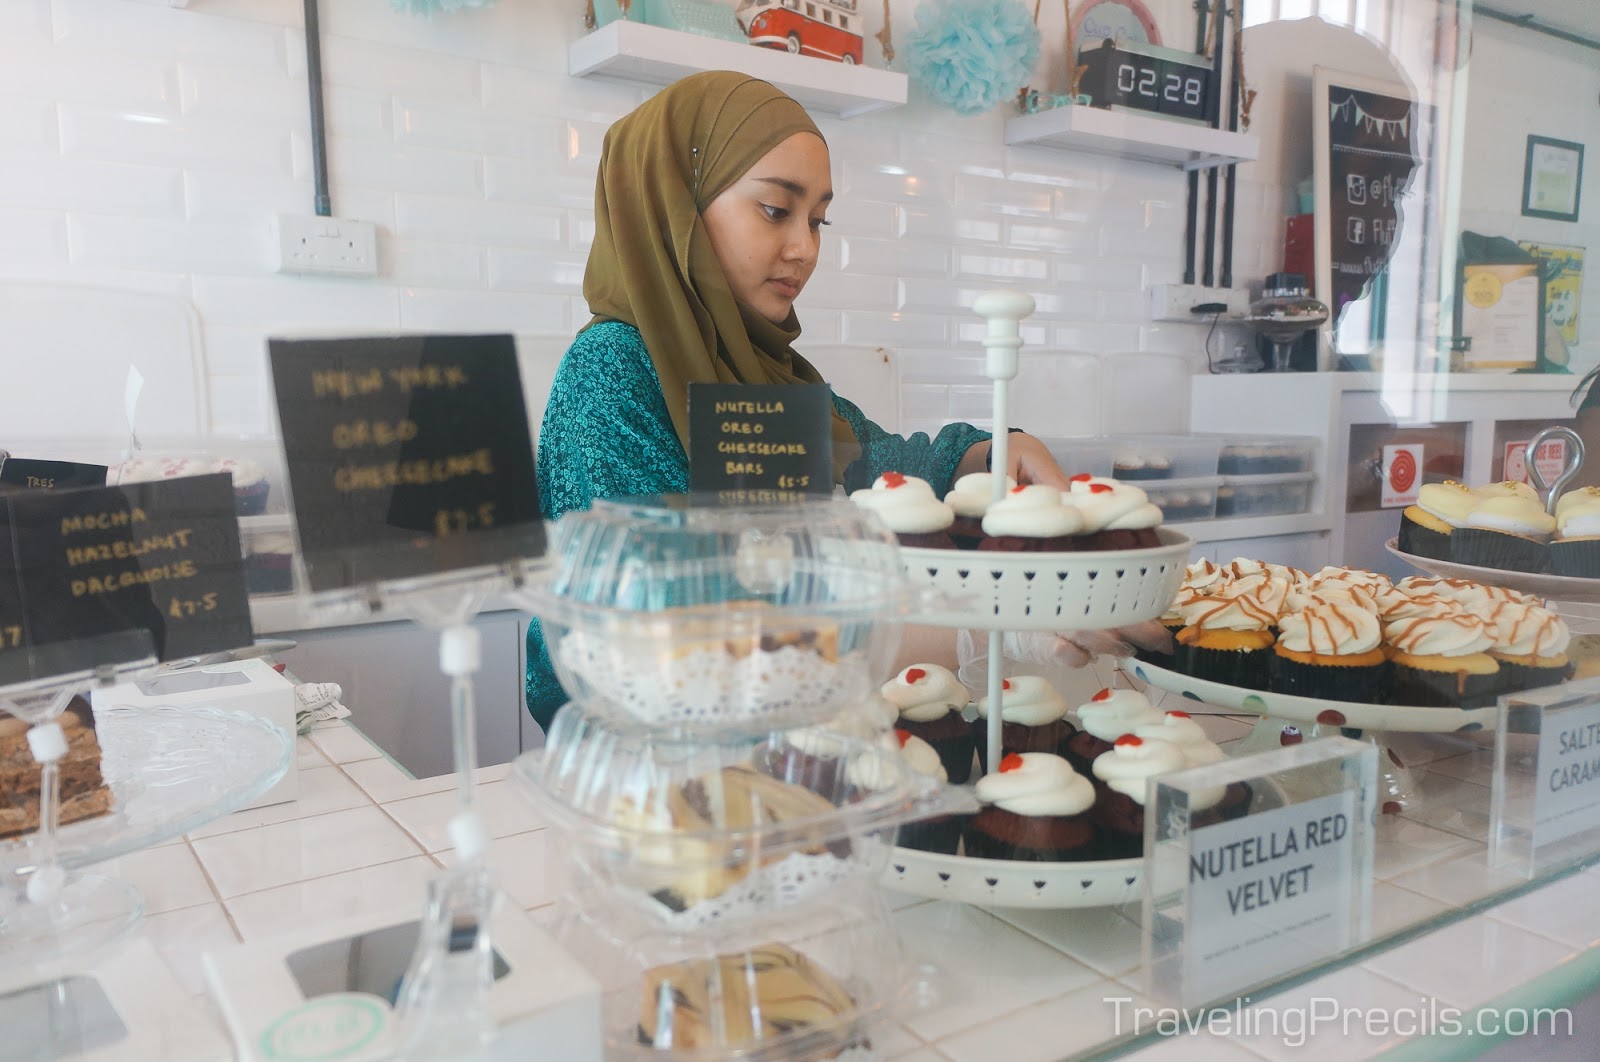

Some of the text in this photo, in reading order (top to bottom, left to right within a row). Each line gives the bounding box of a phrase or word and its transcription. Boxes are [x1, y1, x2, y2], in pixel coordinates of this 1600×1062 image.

[715, 401, 784, 415] NUTELLA
[332, 418, 418, 450] OREO
[721, 422, 764, 435] OREO
[718, 440, 807, 456] CHEESECAKE
[27, 475, 56, 489] TRES
[333, 448, 495, 492] CHEESECAKE
[725, 461, 764, 475] BARS
[60, 507, 147, 535] MOCHA
[66, 528, 193, 566] HAZELNUT
[1189, 813, 1348, 884] NUTELLA RED
[1227, 864, 1315, 917] VELVET
